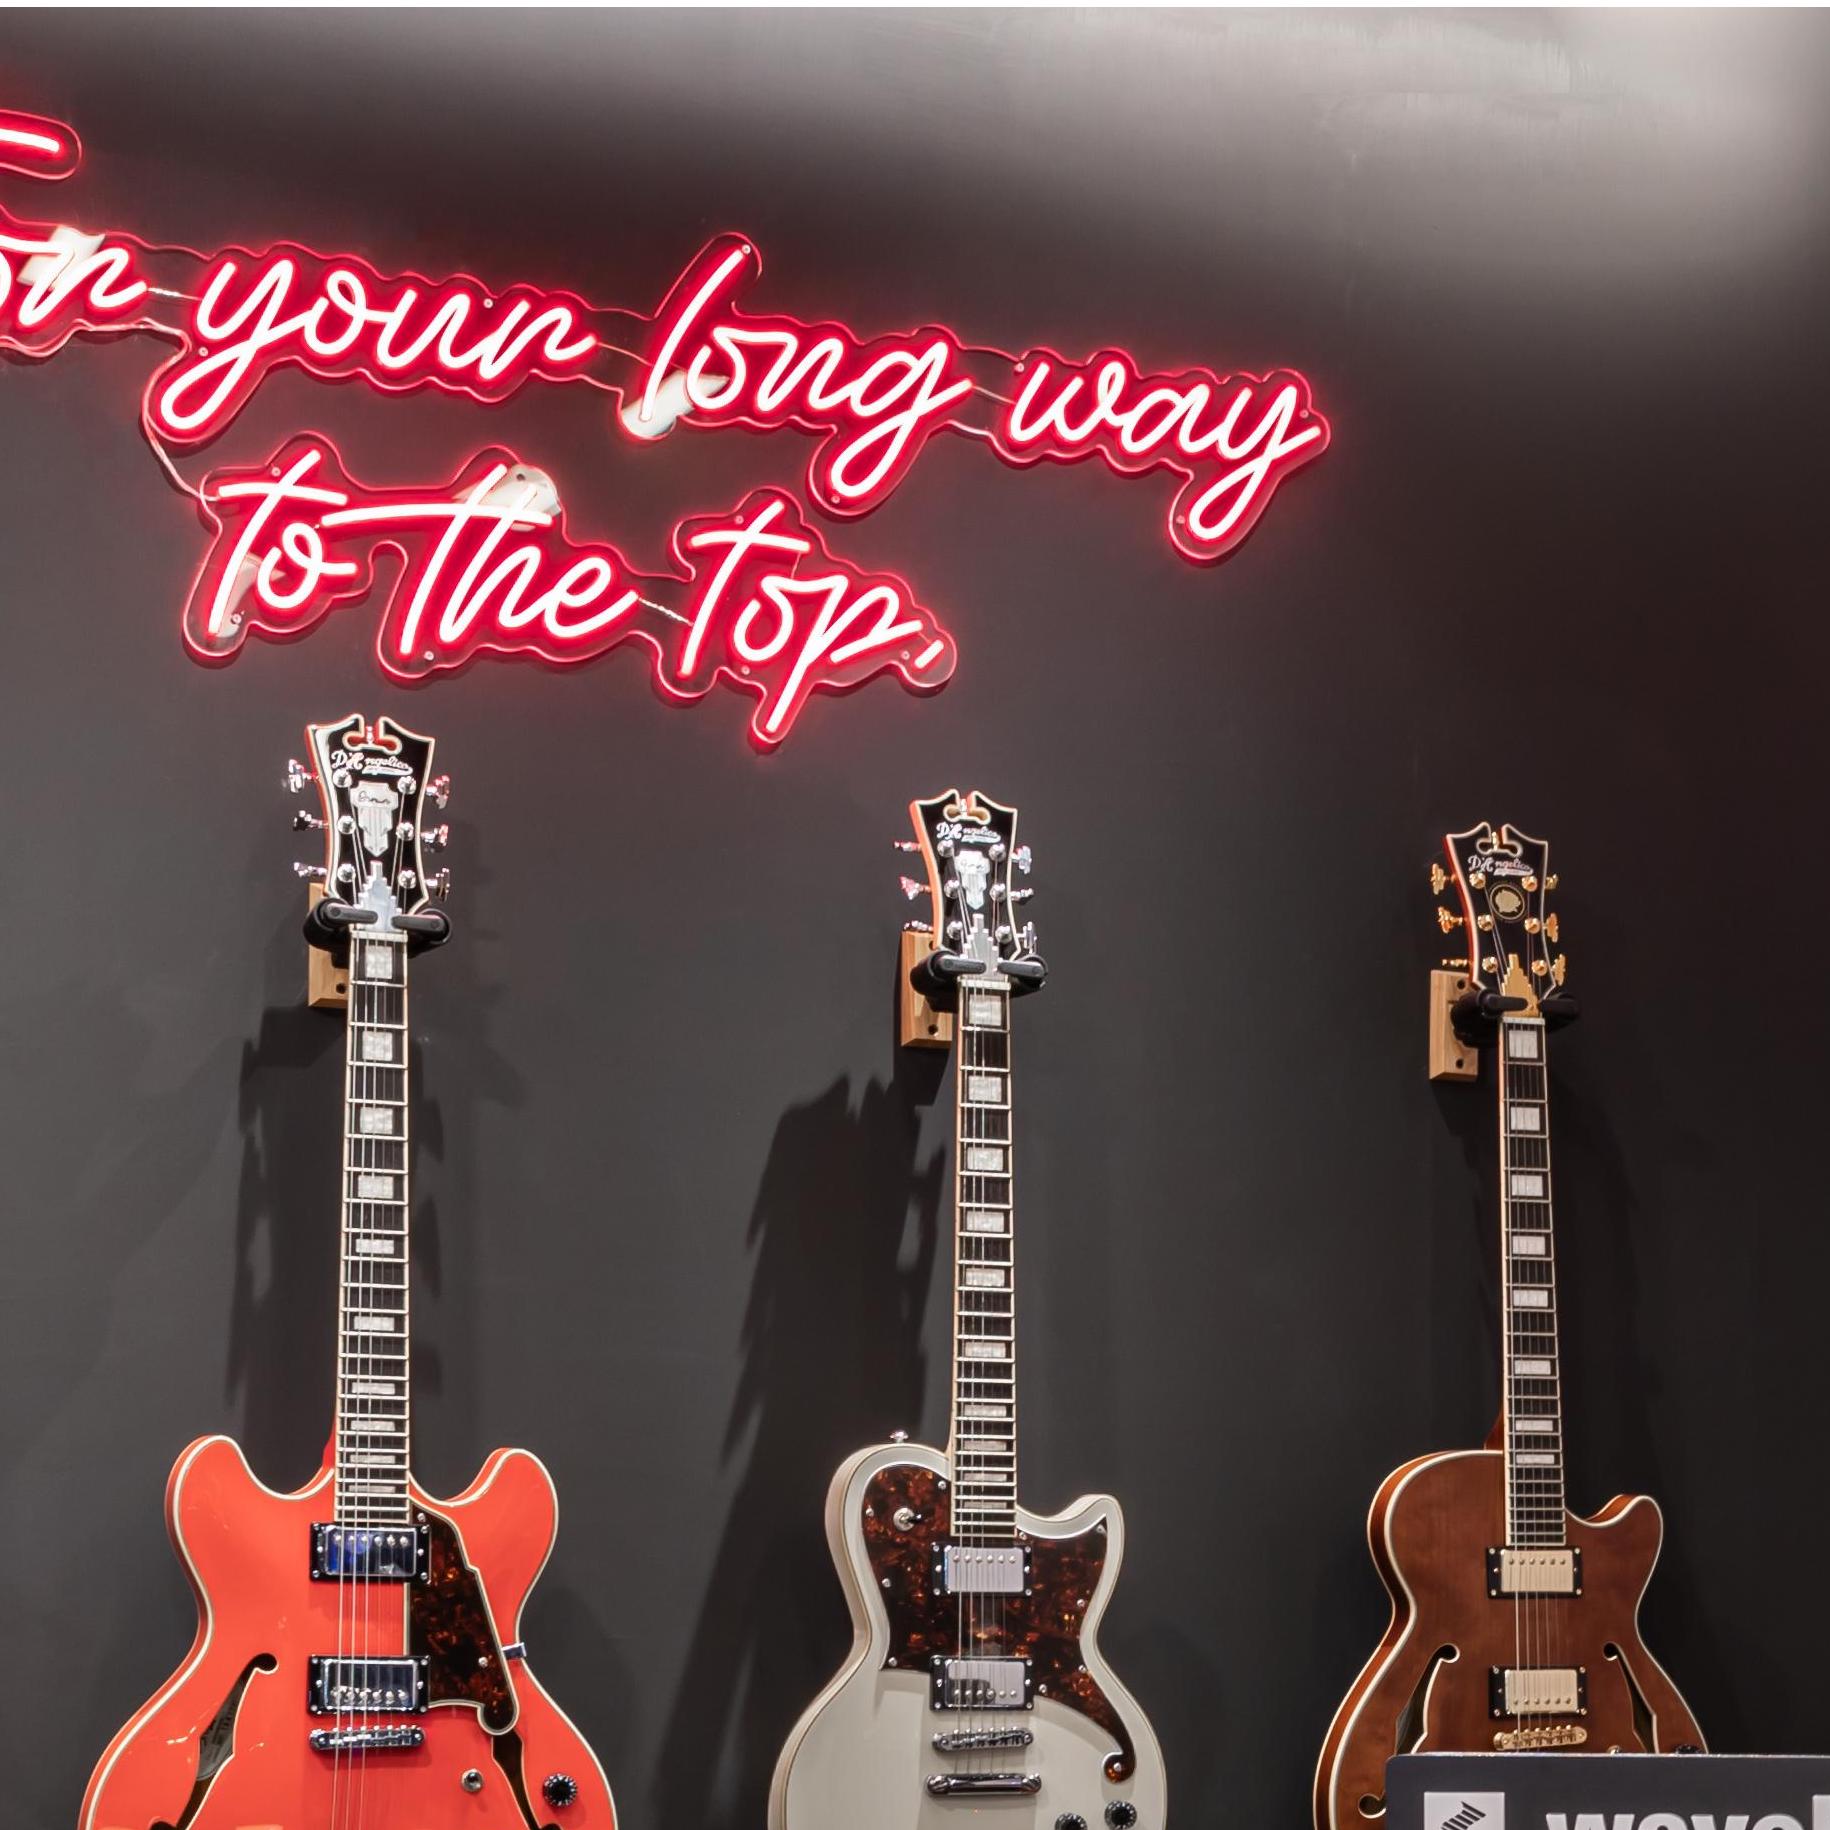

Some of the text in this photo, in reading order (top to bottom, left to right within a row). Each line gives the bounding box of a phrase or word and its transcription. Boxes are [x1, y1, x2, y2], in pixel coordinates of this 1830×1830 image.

[160, 258, 596, 431] your
[640, 247, 974, 499] long
[1008, 360, 1322, 541] way
[207, 448, 358, 635] to
